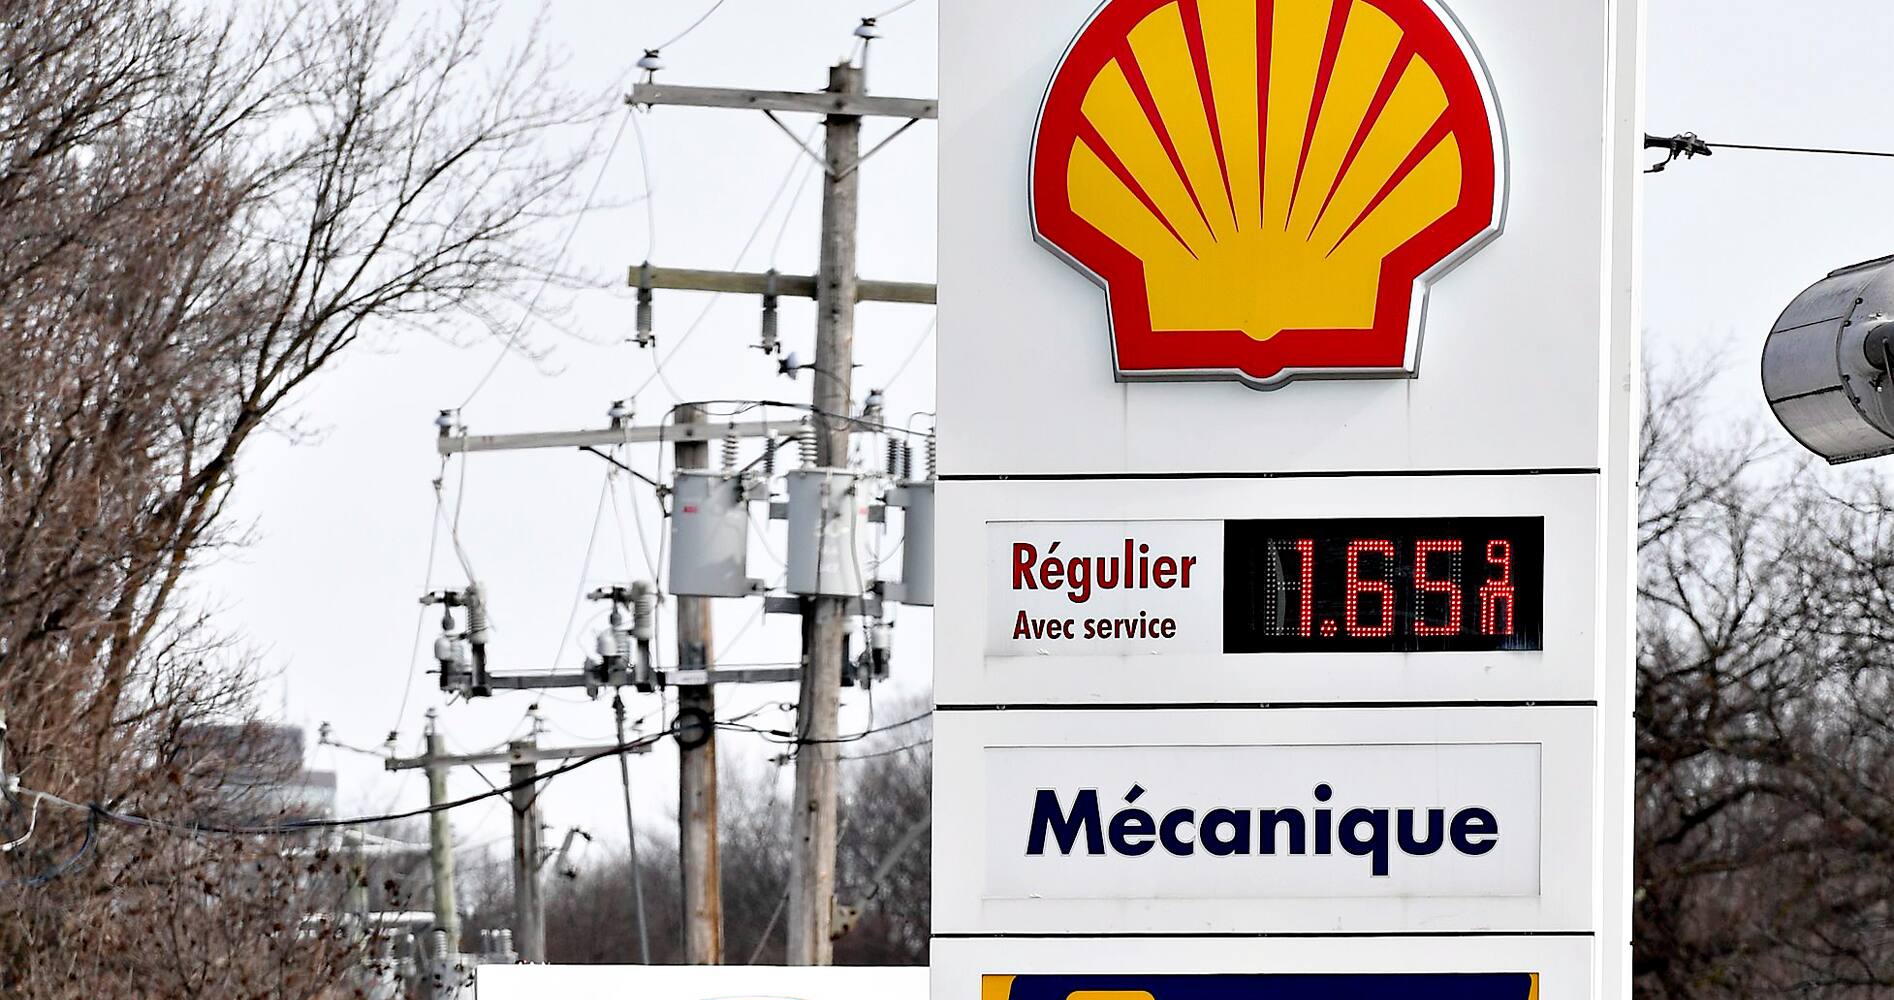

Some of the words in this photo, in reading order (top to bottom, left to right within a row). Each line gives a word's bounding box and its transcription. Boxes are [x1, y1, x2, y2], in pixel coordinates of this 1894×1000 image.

[1012, 538, 1197, 603] Régulier
[1012, 610, 1075, 640] Avec
[1083, 610, 1177, 640] service
[1026, 782, 1499, 876] Mécanique
